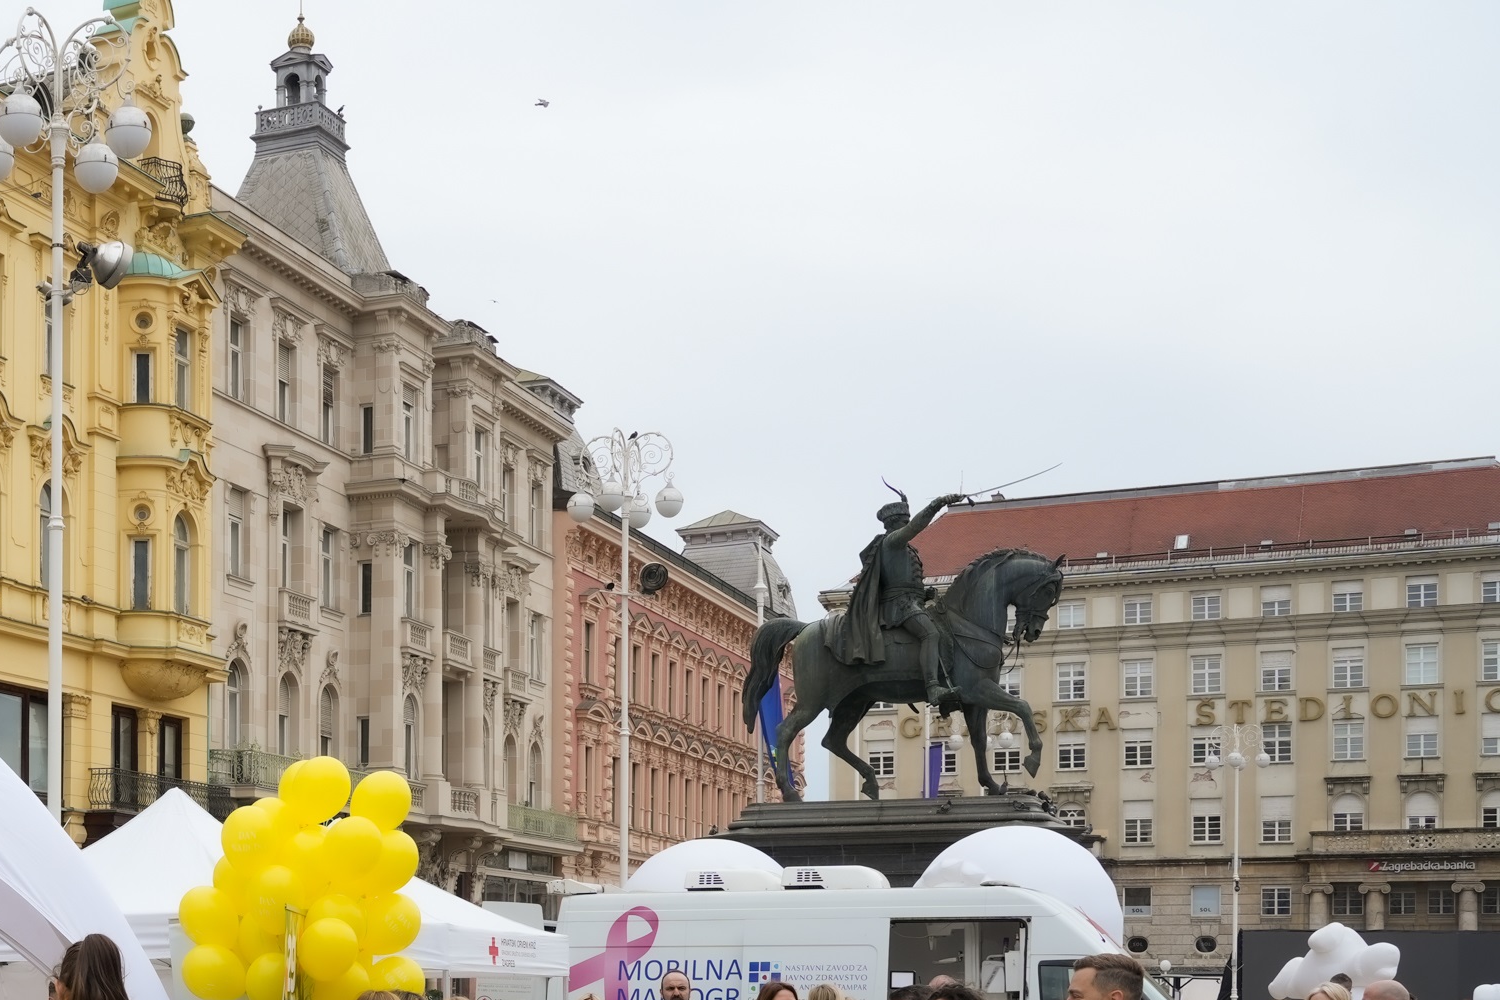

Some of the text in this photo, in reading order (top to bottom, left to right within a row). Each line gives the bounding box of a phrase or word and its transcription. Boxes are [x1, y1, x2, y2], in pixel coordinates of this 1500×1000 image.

[1381, 860, 1476, 873] Zagrebačka banka
[784, 974, 812, 982] JAVNO
